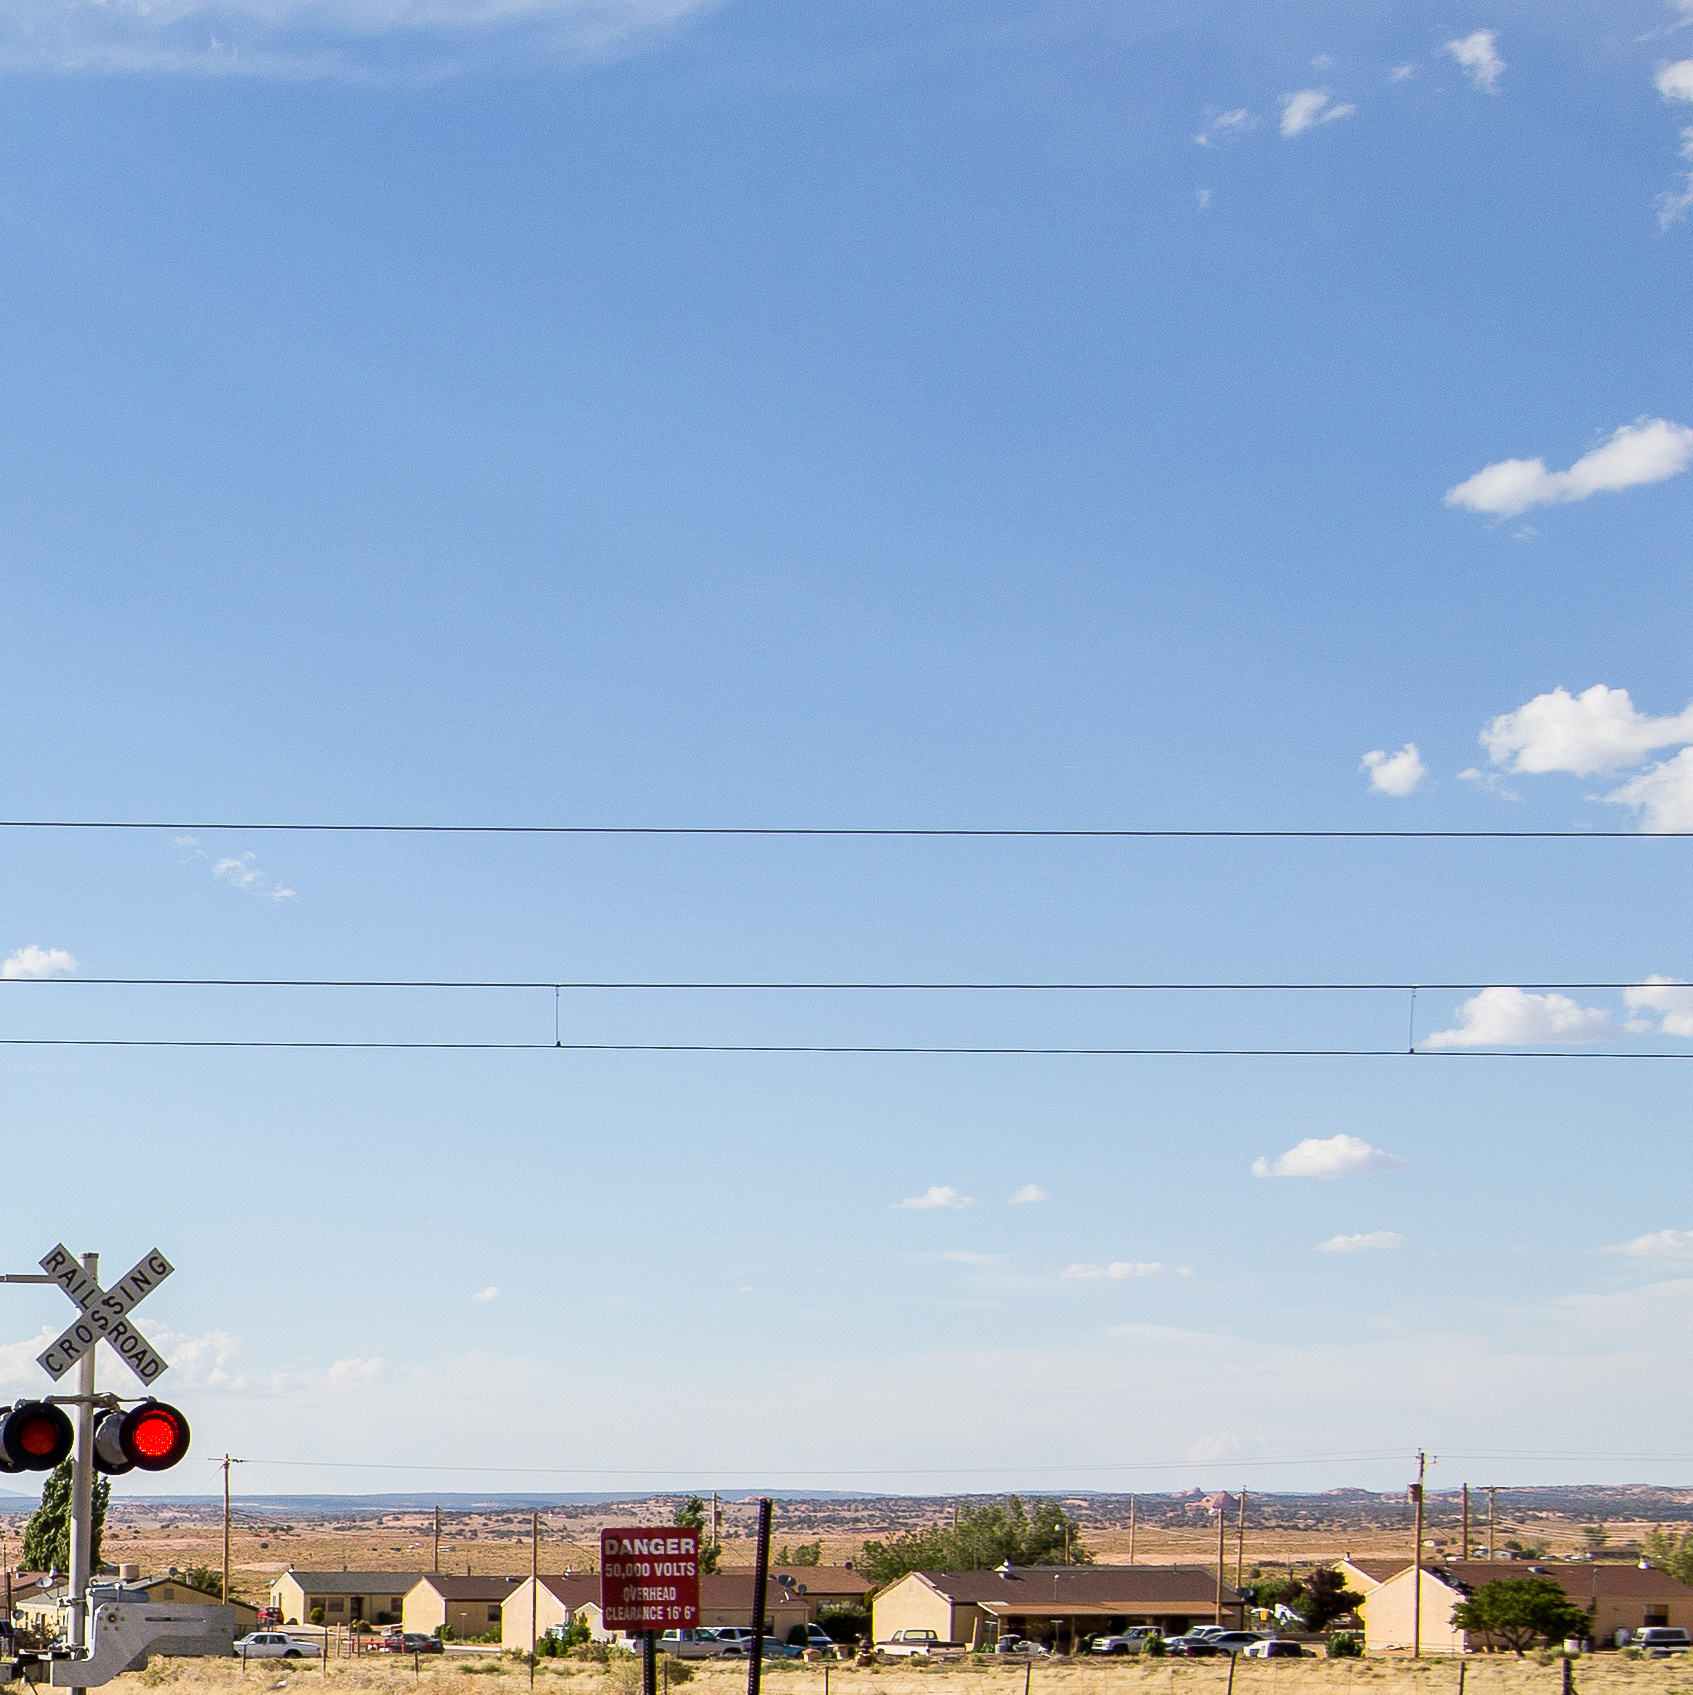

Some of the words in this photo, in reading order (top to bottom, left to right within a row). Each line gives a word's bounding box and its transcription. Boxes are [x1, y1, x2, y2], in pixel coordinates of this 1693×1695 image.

[45, 1256, 167, 1372] CROSSING
[605, 1538, 695, 1555] DANGER
[605, 1563, 650, 1579] 50,000
[654, 1562, 695, 1577] VOLTS
[623, 1586, 676, 1601] OVERHEAD
[606, 1606, 663, 1620] CLEARANCE
